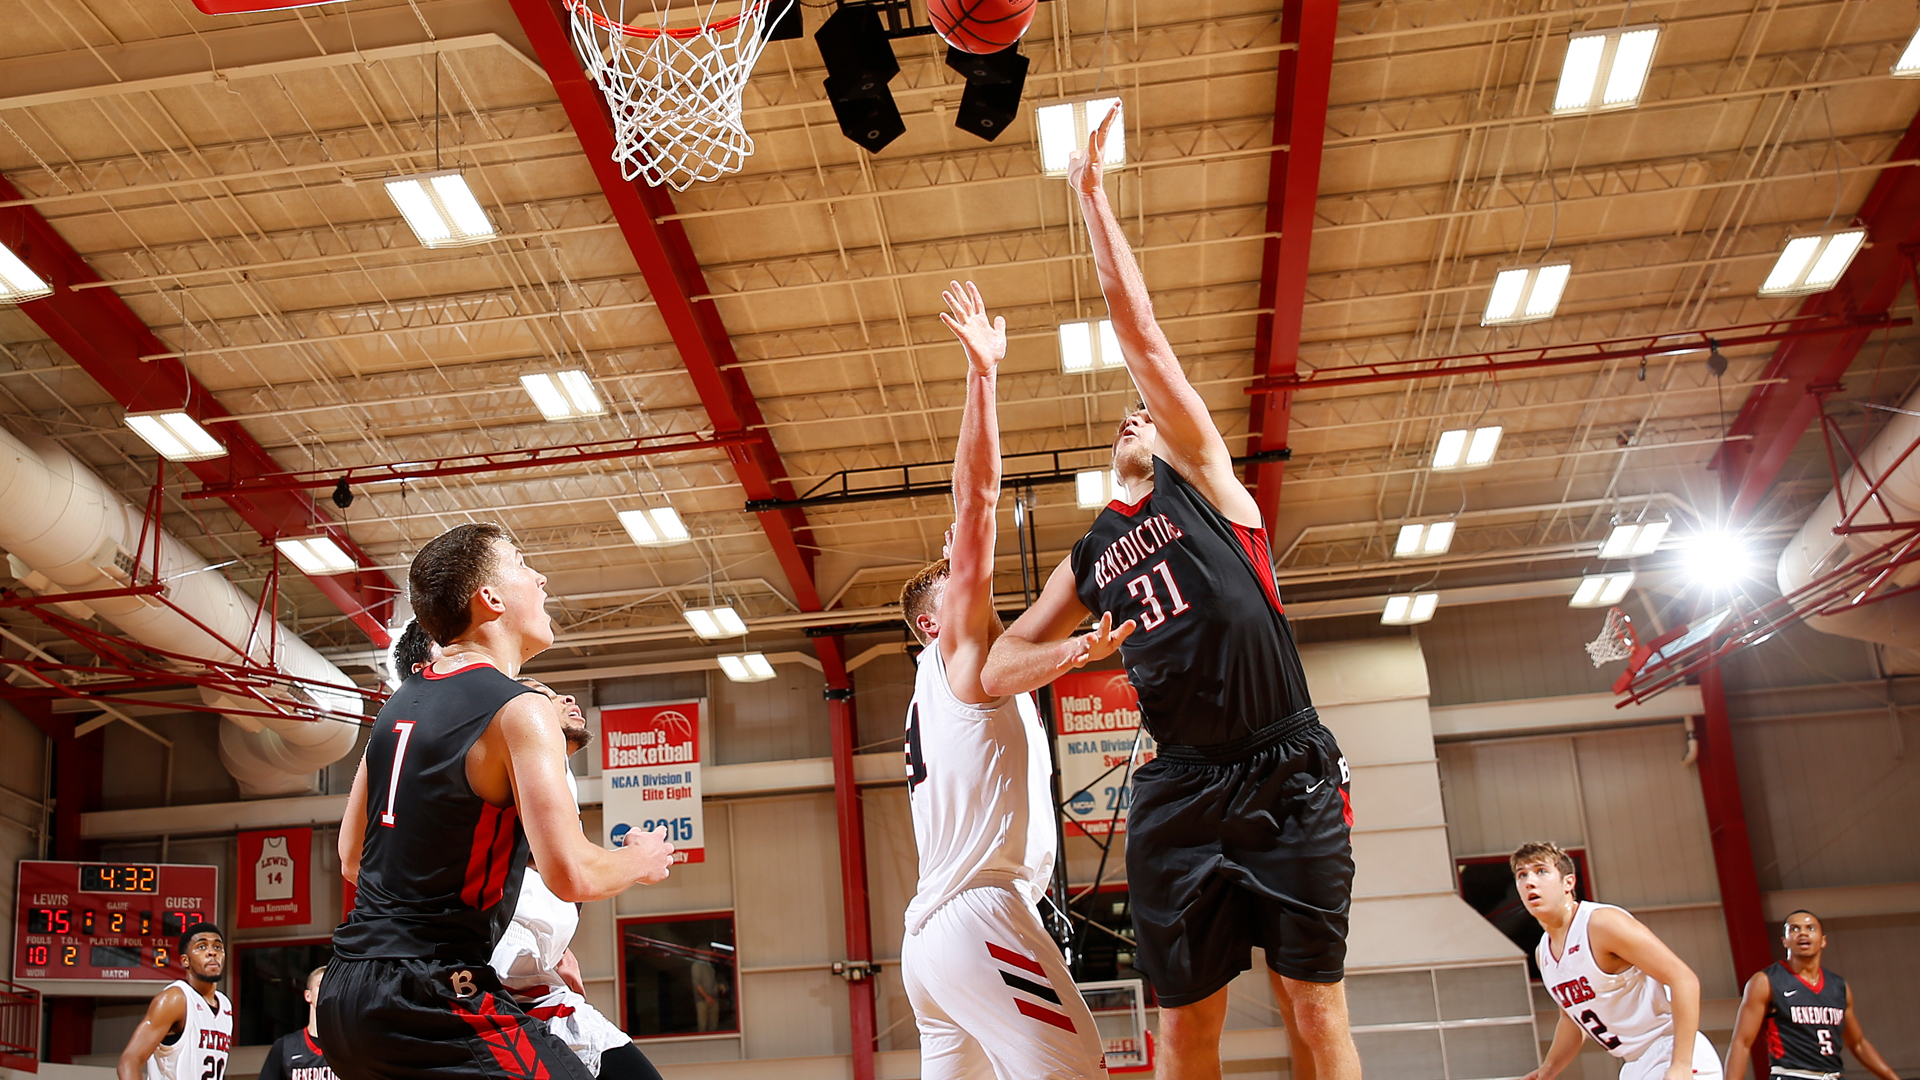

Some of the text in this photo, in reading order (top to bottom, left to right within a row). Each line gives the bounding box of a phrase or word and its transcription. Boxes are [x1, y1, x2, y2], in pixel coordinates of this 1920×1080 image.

[1126, 559, 1191, 633] 31
[1061, 695, 1102, 713] Men's
[1063, 708, 1141, 732] Basketba
[608, 728, 666, 747] Women's
[609, 741, 693, 767] Basketball
[1068, 742, 1098, 755] NCAA
[380, 719, 416, 828] 1
[612, 776, 639, 789] NCAA
[643, 772, 682, 787] Division
[643, 787, 692, 801] Elite Eight
[1105, 786, 1130, 810] 20
[261, 856, 288, 869] LEWIS
[100, 867, 154, 891] 4:32
[267, 872, 283, 884] 14
[33, 894, 69, 906] LEWIS
[107, 902, 129, 910] GAME
[166, 897, 202, 909] GUEST
[40, 909, 70, 934] 75
[111, 913, 123, 932] 2
[26, 936, 52, 945] FOULS
[90, 937, 143, 946] PLAYER FOUL
[28, 946, 47, 965] 10
[64, 946, 77, 965] 2
[155, 948, 167, 967] 2
[102, 969, 130, 979] MATCH
[449, 970, 477, 999] B
[1816, 1028, 1834, 1056] 5
